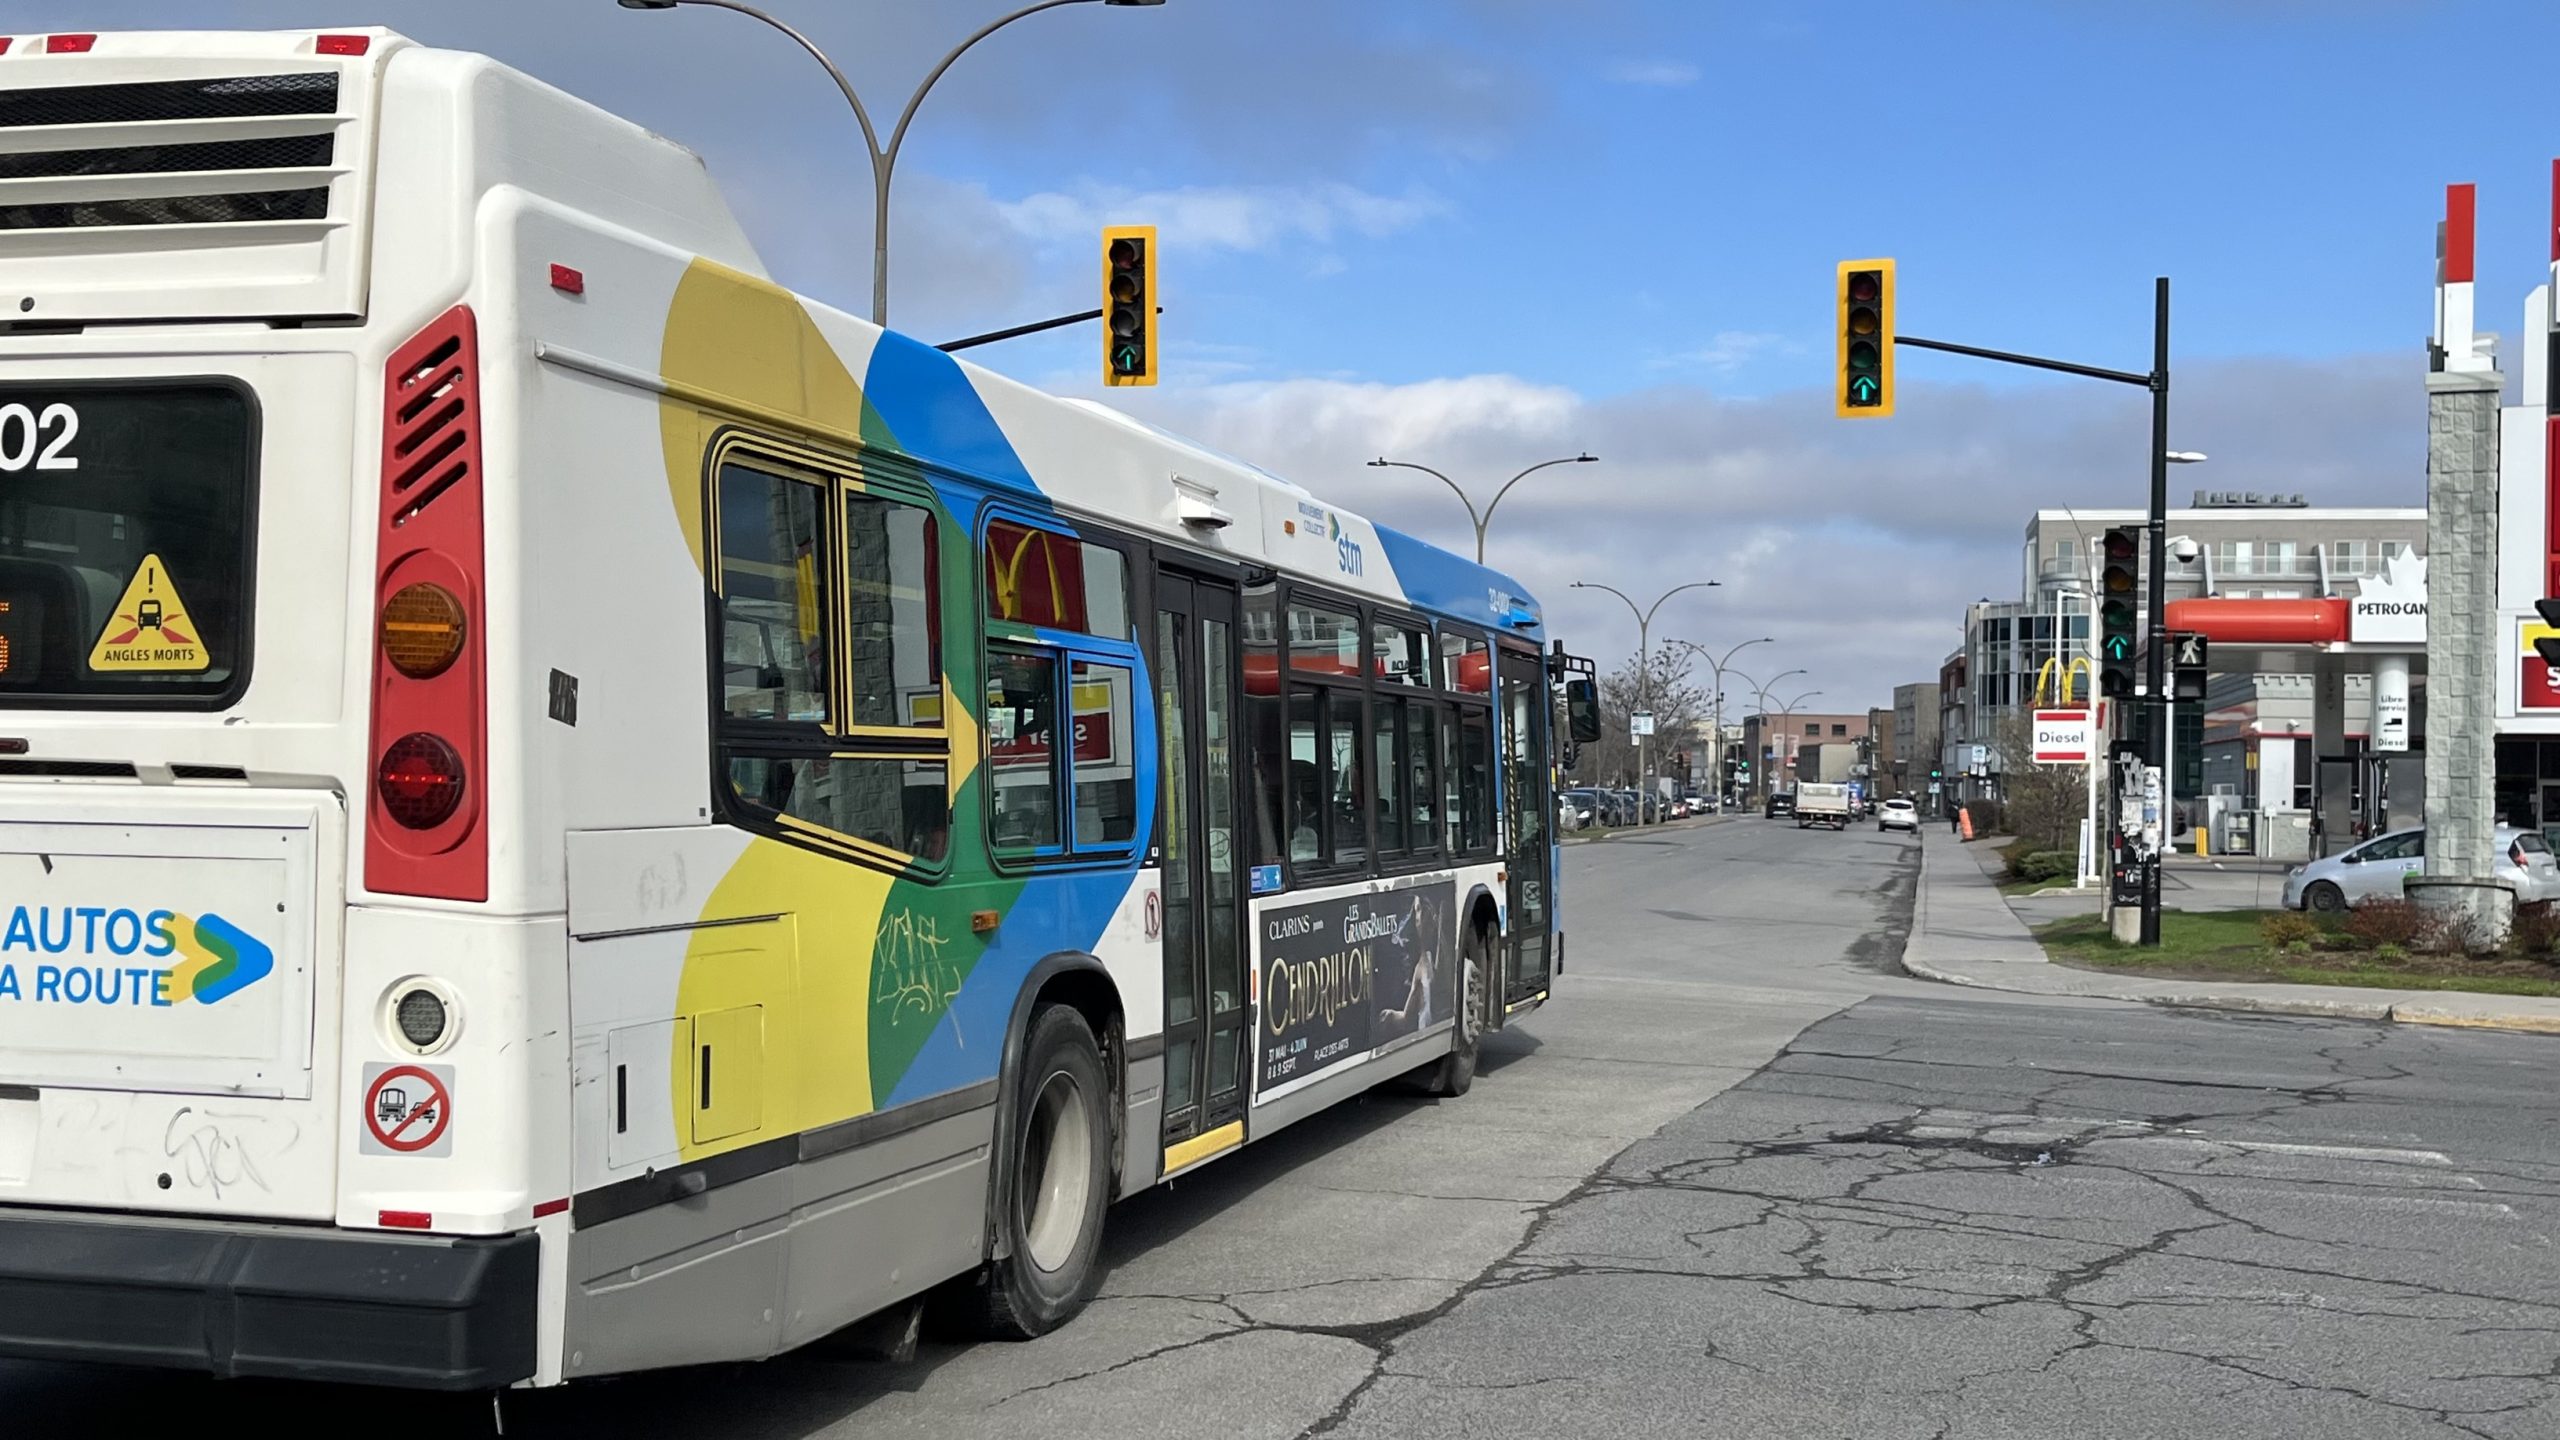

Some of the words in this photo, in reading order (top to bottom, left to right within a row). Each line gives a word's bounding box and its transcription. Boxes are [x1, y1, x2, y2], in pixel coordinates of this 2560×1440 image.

[1338, 532, 1362, 577] stm
[104, 649, 150, 662] ANGLES
[153, 649, 195, 661] MORTS
[2039, 731, 2084, 743] Diesel
[2378, 737, 2406, 747] Diesel
[1349, 904, 1359, 921] LES
[2, 905, 176, 957] AUTOS
[1268, 914, 1310, 941] CLARINS
[36, 965, 174, 1007] ROUTE
[1267, 945, 1372, 1037] CENDRILLON
[1275, 1043, 1287, 1060] MAI
